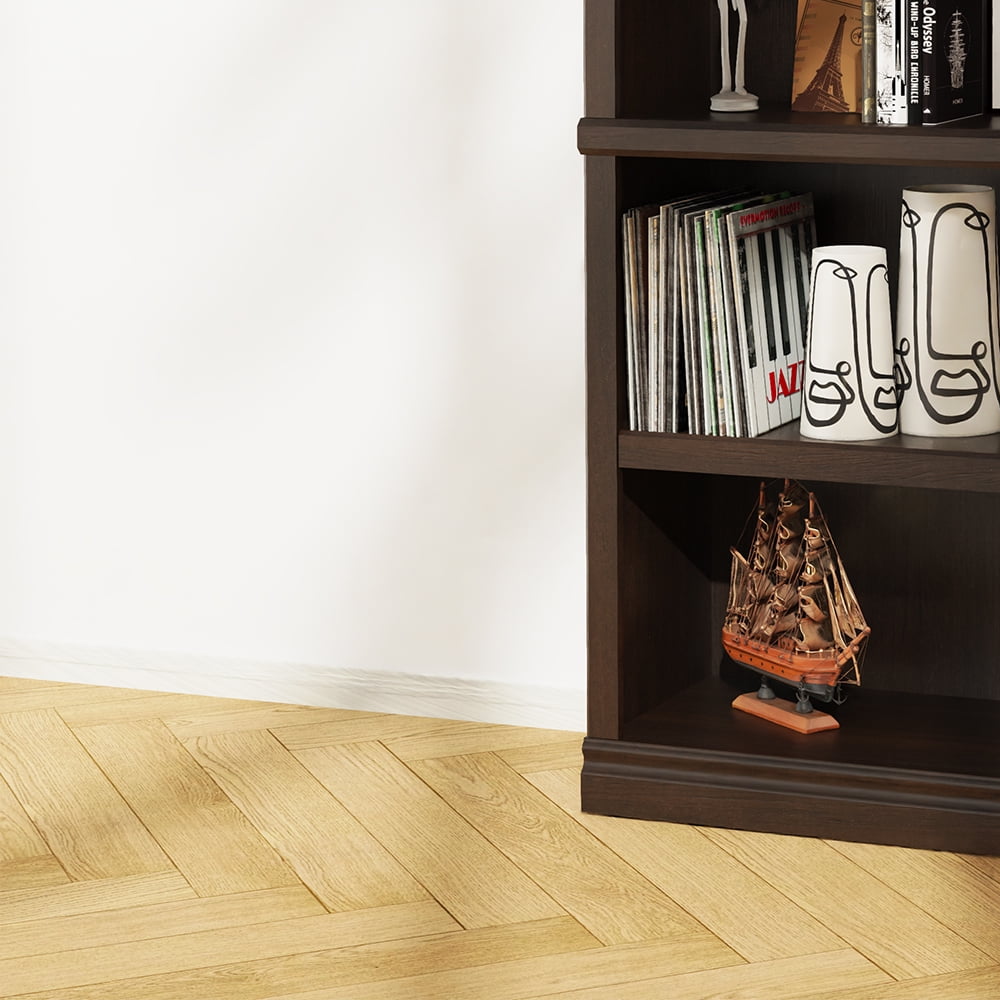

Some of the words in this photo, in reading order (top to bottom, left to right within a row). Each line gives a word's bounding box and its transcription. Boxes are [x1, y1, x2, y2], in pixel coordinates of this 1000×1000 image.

[910, 1, 919, 38] WIND-UP
[922, 7, 936, 54] Odyssey
[910, 41, 919, 60] BIRD
[910, 62, 919, 104] CHRONICLE
